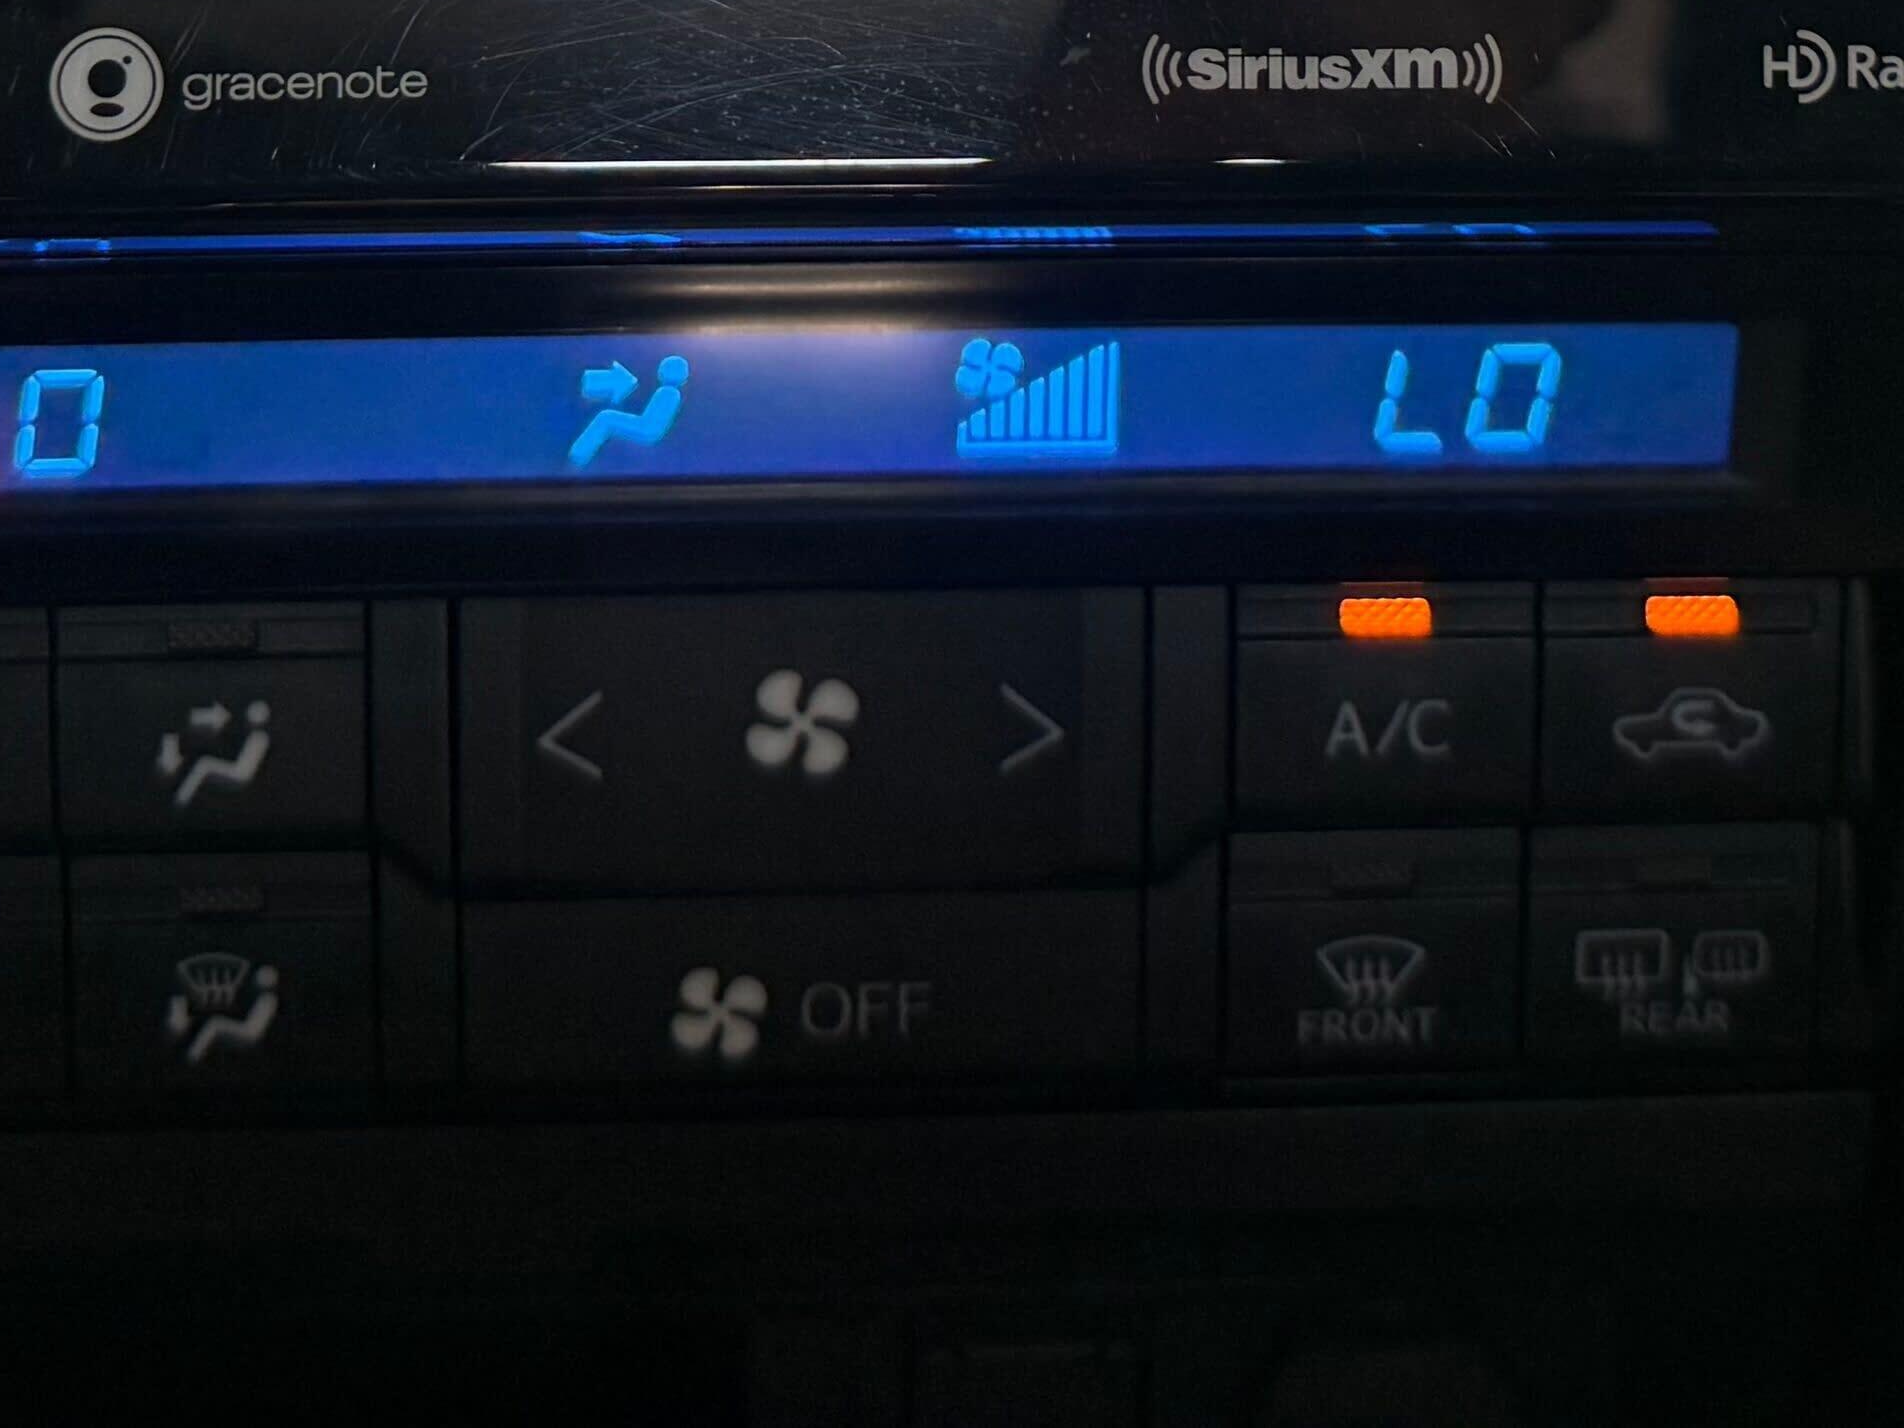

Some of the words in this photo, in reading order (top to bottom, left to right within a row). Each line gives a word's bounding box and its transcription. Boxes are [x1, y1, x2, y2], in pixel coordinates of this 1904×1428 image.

[181, 65, 429, 111] gracenote
[1325, 700, 1452, 757] A/C
[800, 982, 932, 1039] OFF
[1298, 1007, 1438, 1043] FRONT
[1621, 1002, 1730, 1036] REAR
